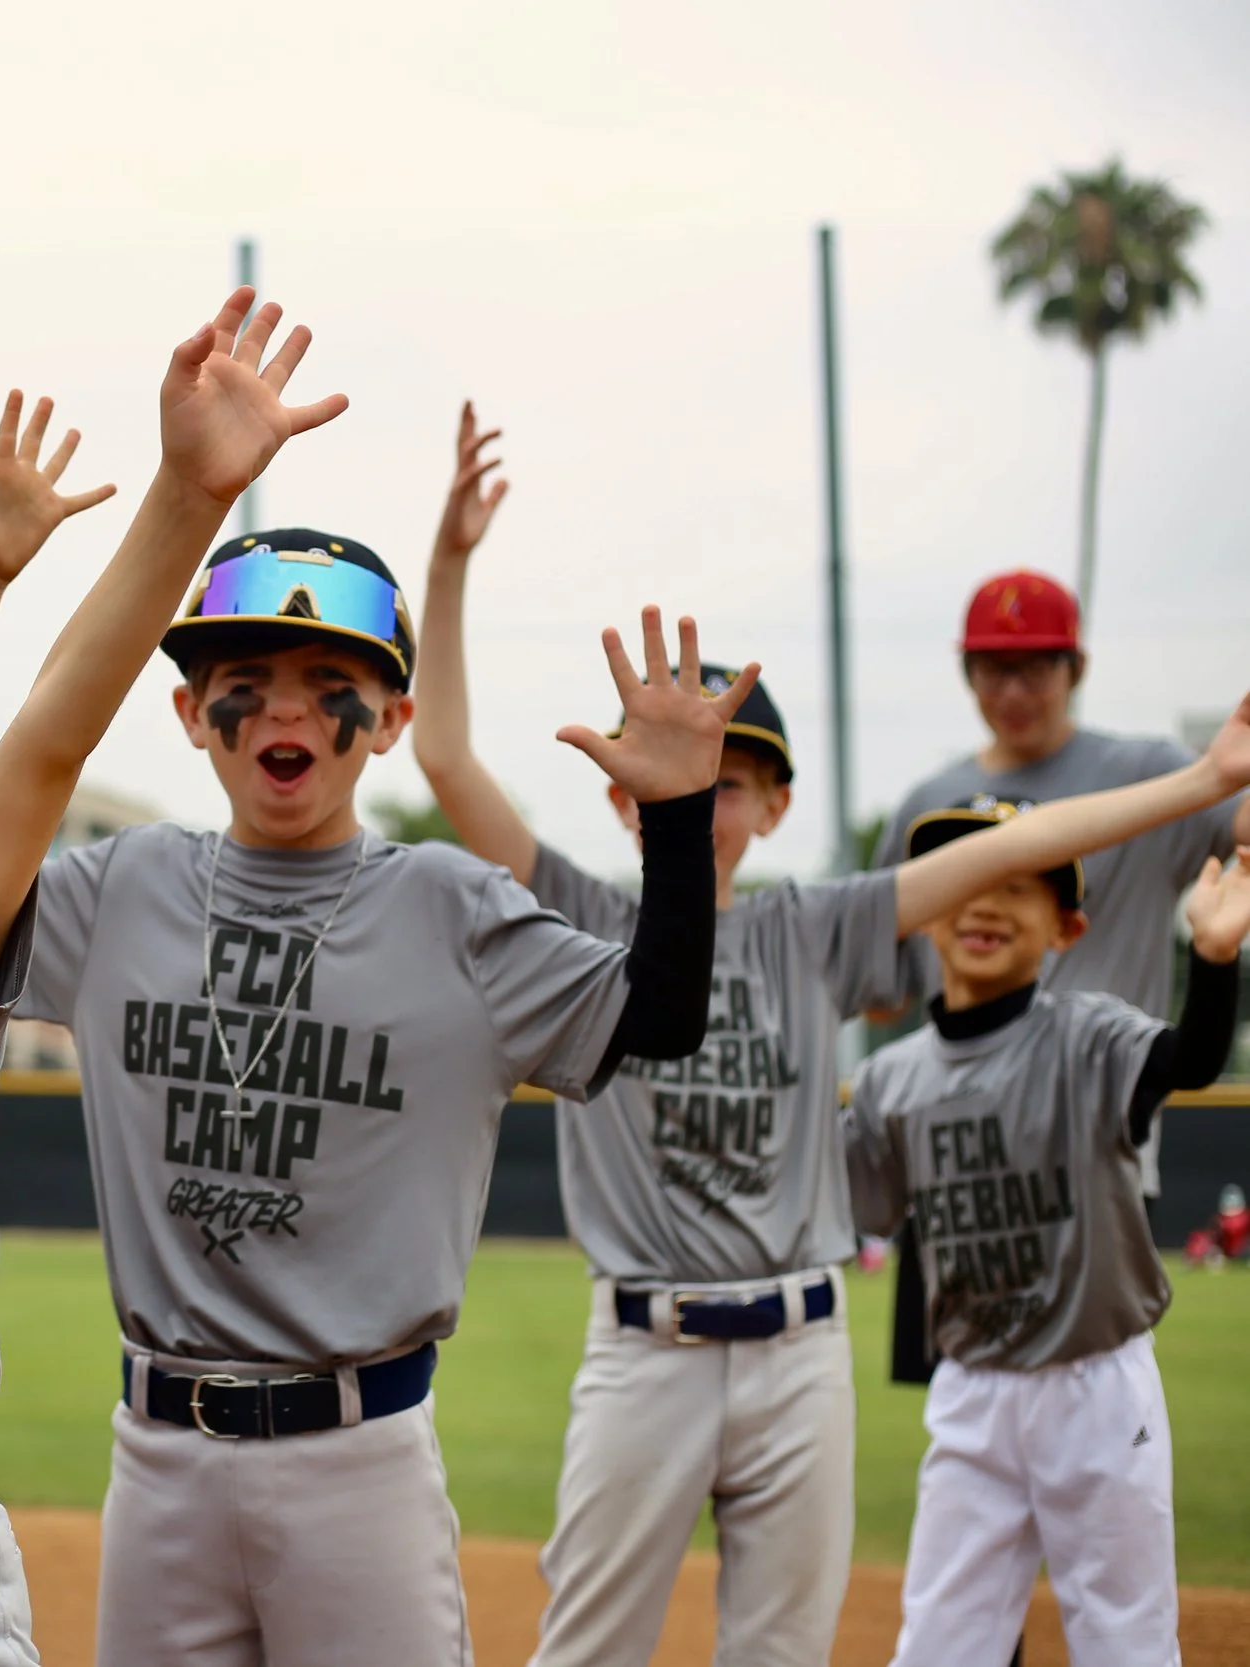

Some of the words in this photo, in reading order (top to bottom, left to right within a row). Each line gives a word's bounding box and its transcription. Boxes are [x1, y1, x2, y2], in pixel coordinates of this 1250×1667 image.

[201, 928, 316, 1011] FCA
[123, 1000, 404, 1113] BASEBALL
[164, 1086, 322, 1180] CAMP
[654, 1091, 774, 1156] CAMP
[930, 1114, 1008, 1179] FCA
[166, 1177, 304, 1238] GREATER
